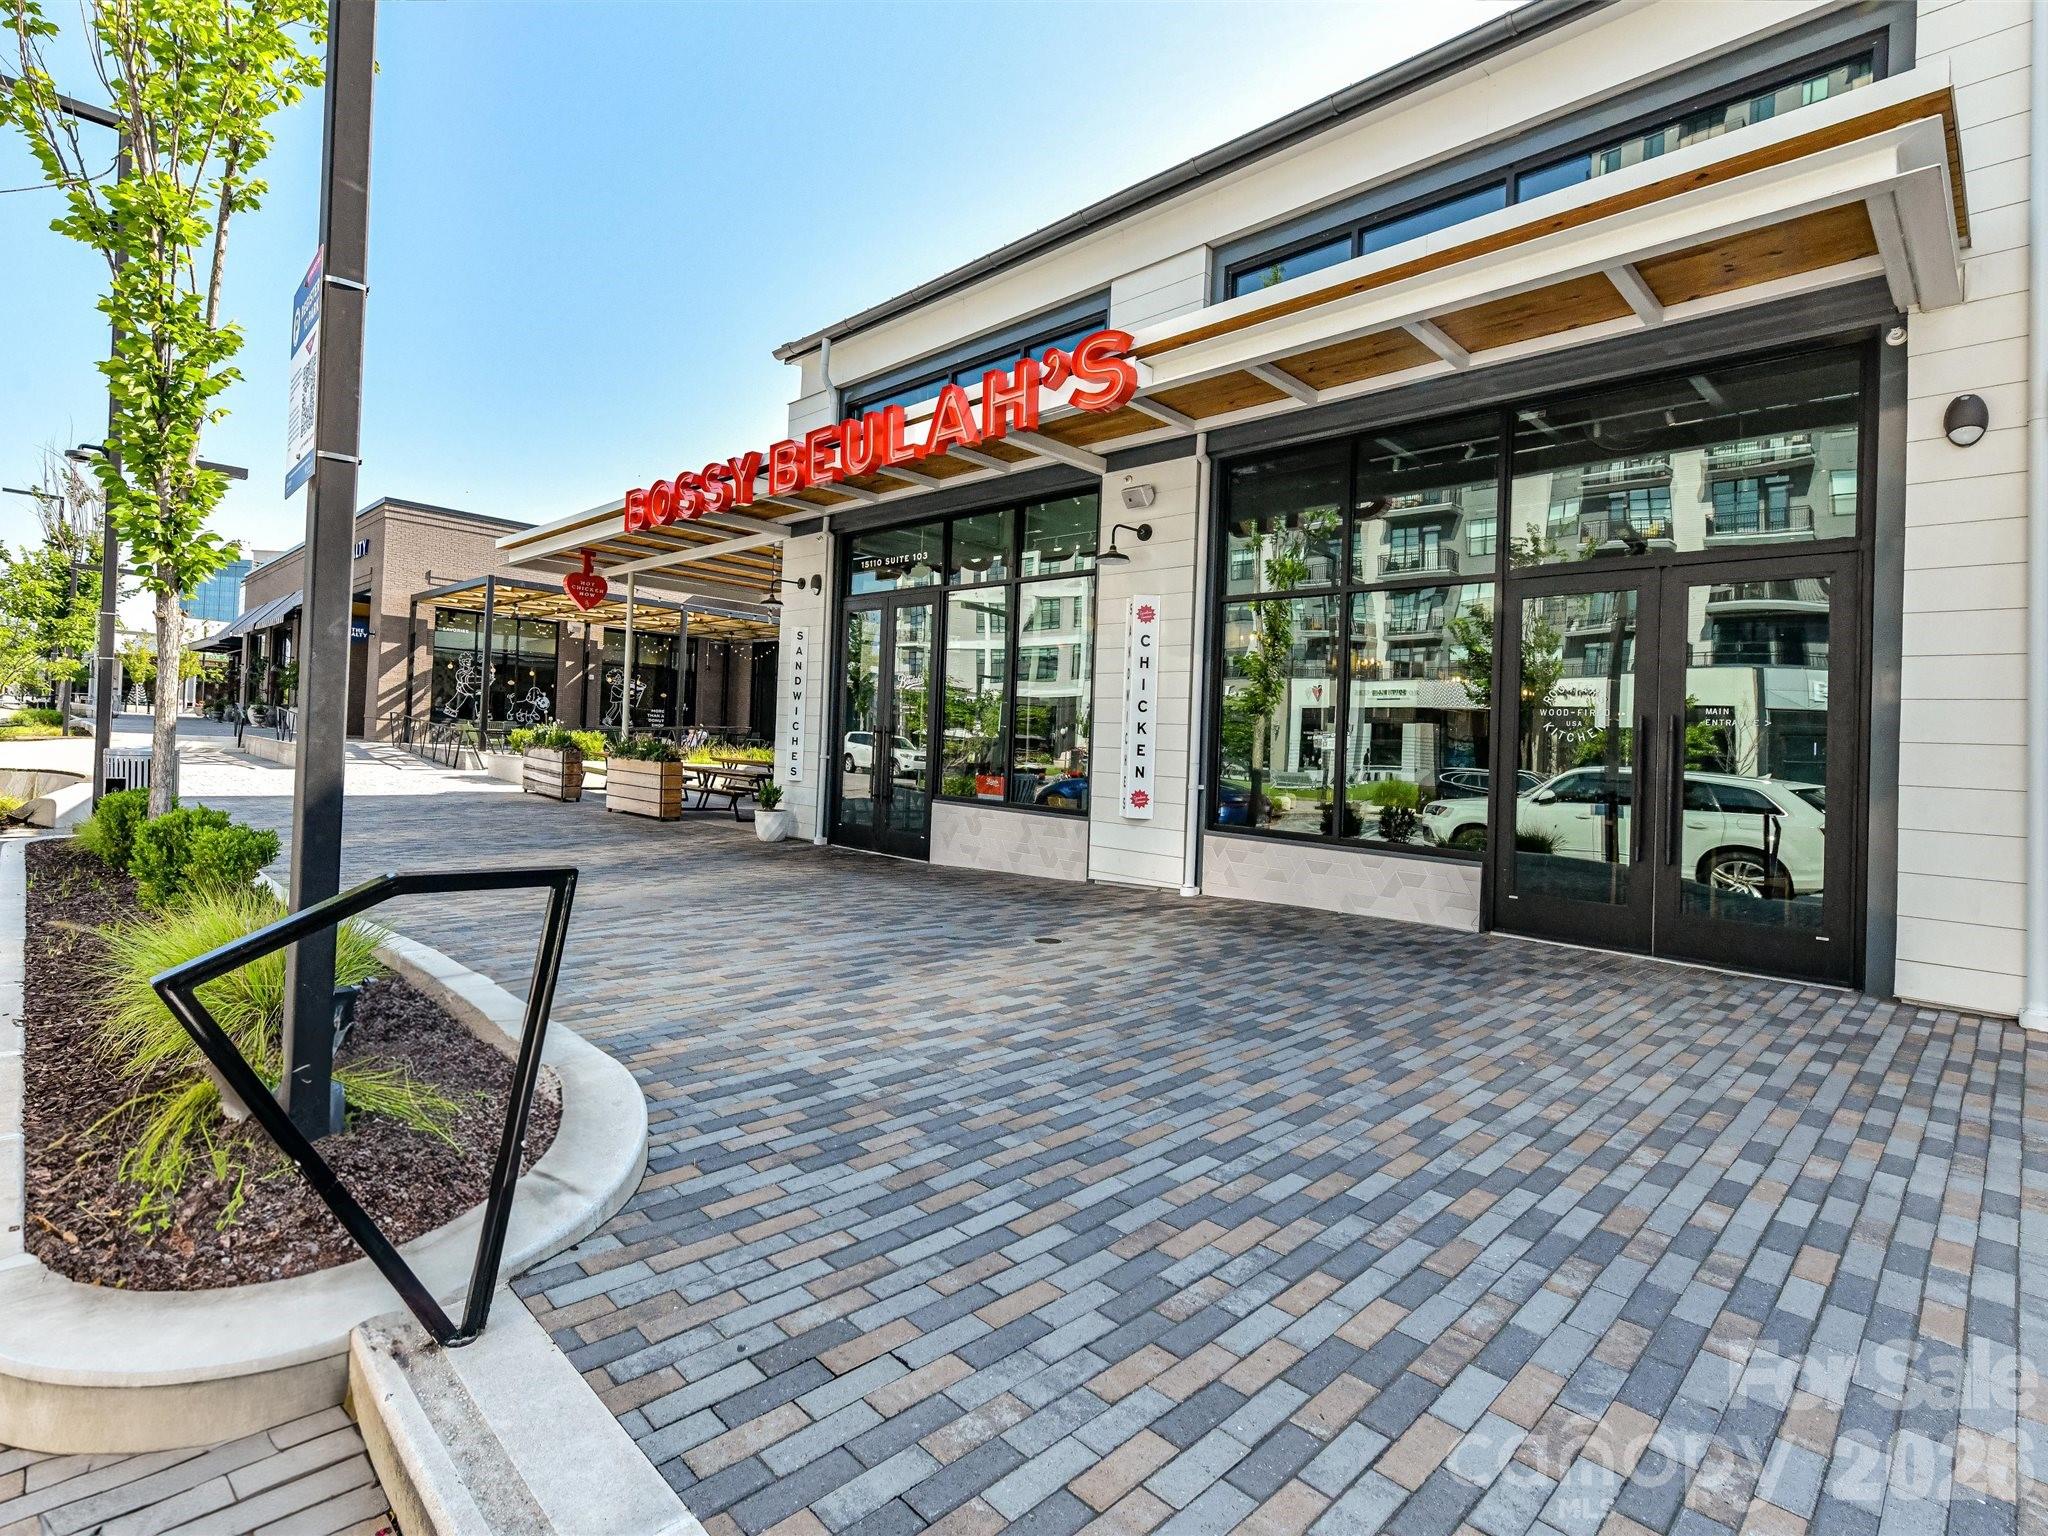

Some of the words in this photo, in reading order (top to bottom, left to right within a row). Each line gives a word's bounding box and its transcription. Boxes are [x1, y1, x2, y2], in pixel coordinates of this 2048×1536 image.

[624, 450, 764, 533] BOSSY
[768, 329, 1139, 497] BEULAH'S
[861, 558, 882, 569] 15110
[885, 554, 910, 566] SUITE
[912, 551, 928, 561] 103
[571, 584, 604, 594] CHICKEN
[790, 631, 804, 776] SANDWICHES
[1134, 634, 1151, 779] CHICKEN
[1539, 708, 1610, 717] WOOD-FIRD
[1705, 719, 1760, 727] ENTRAE
